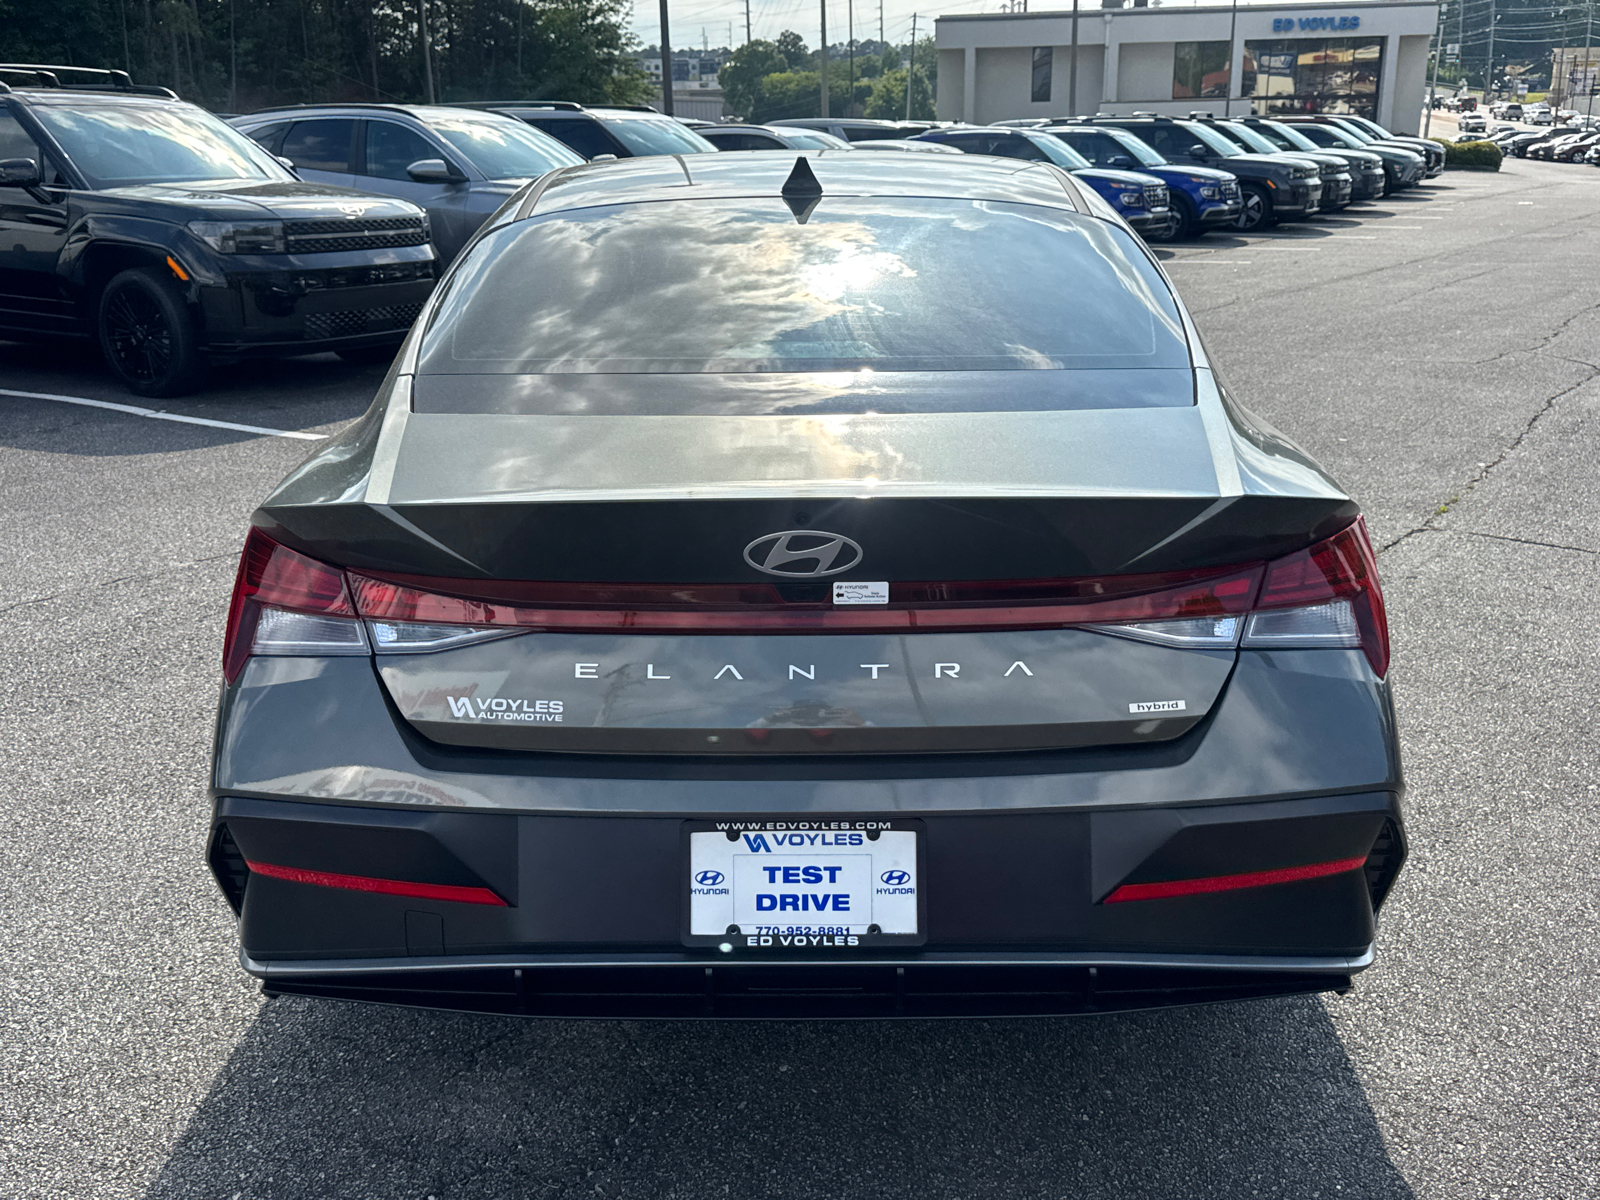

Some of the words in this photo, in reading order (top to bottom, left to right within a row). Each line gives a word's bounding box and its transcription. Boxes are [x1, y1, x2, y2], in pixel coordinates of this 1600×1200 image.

[1272, 18, 1295, 32] ED
[1298, 16, 1360, 31] VOYLES
[574, 661, 1034, 680] ELANTRA
[476, 698, 563, 713] VOYLES
[1137, 702, 1179, 711] hybrid
[477, 712, 563, 722] AUTOMOTIVE
[716, 822, 891, 830] WWW.EDVOYLES.COM
[772, 834, 863, 846] VOYLES
[763, 866, 842, 884] TEST
[756, 894, 850, 912] DRIVE
[756, 926, 850, 935] 770-952-8881
[747, 936, 773, 946] ED
[780, 936, 859, 946] VOYLES
